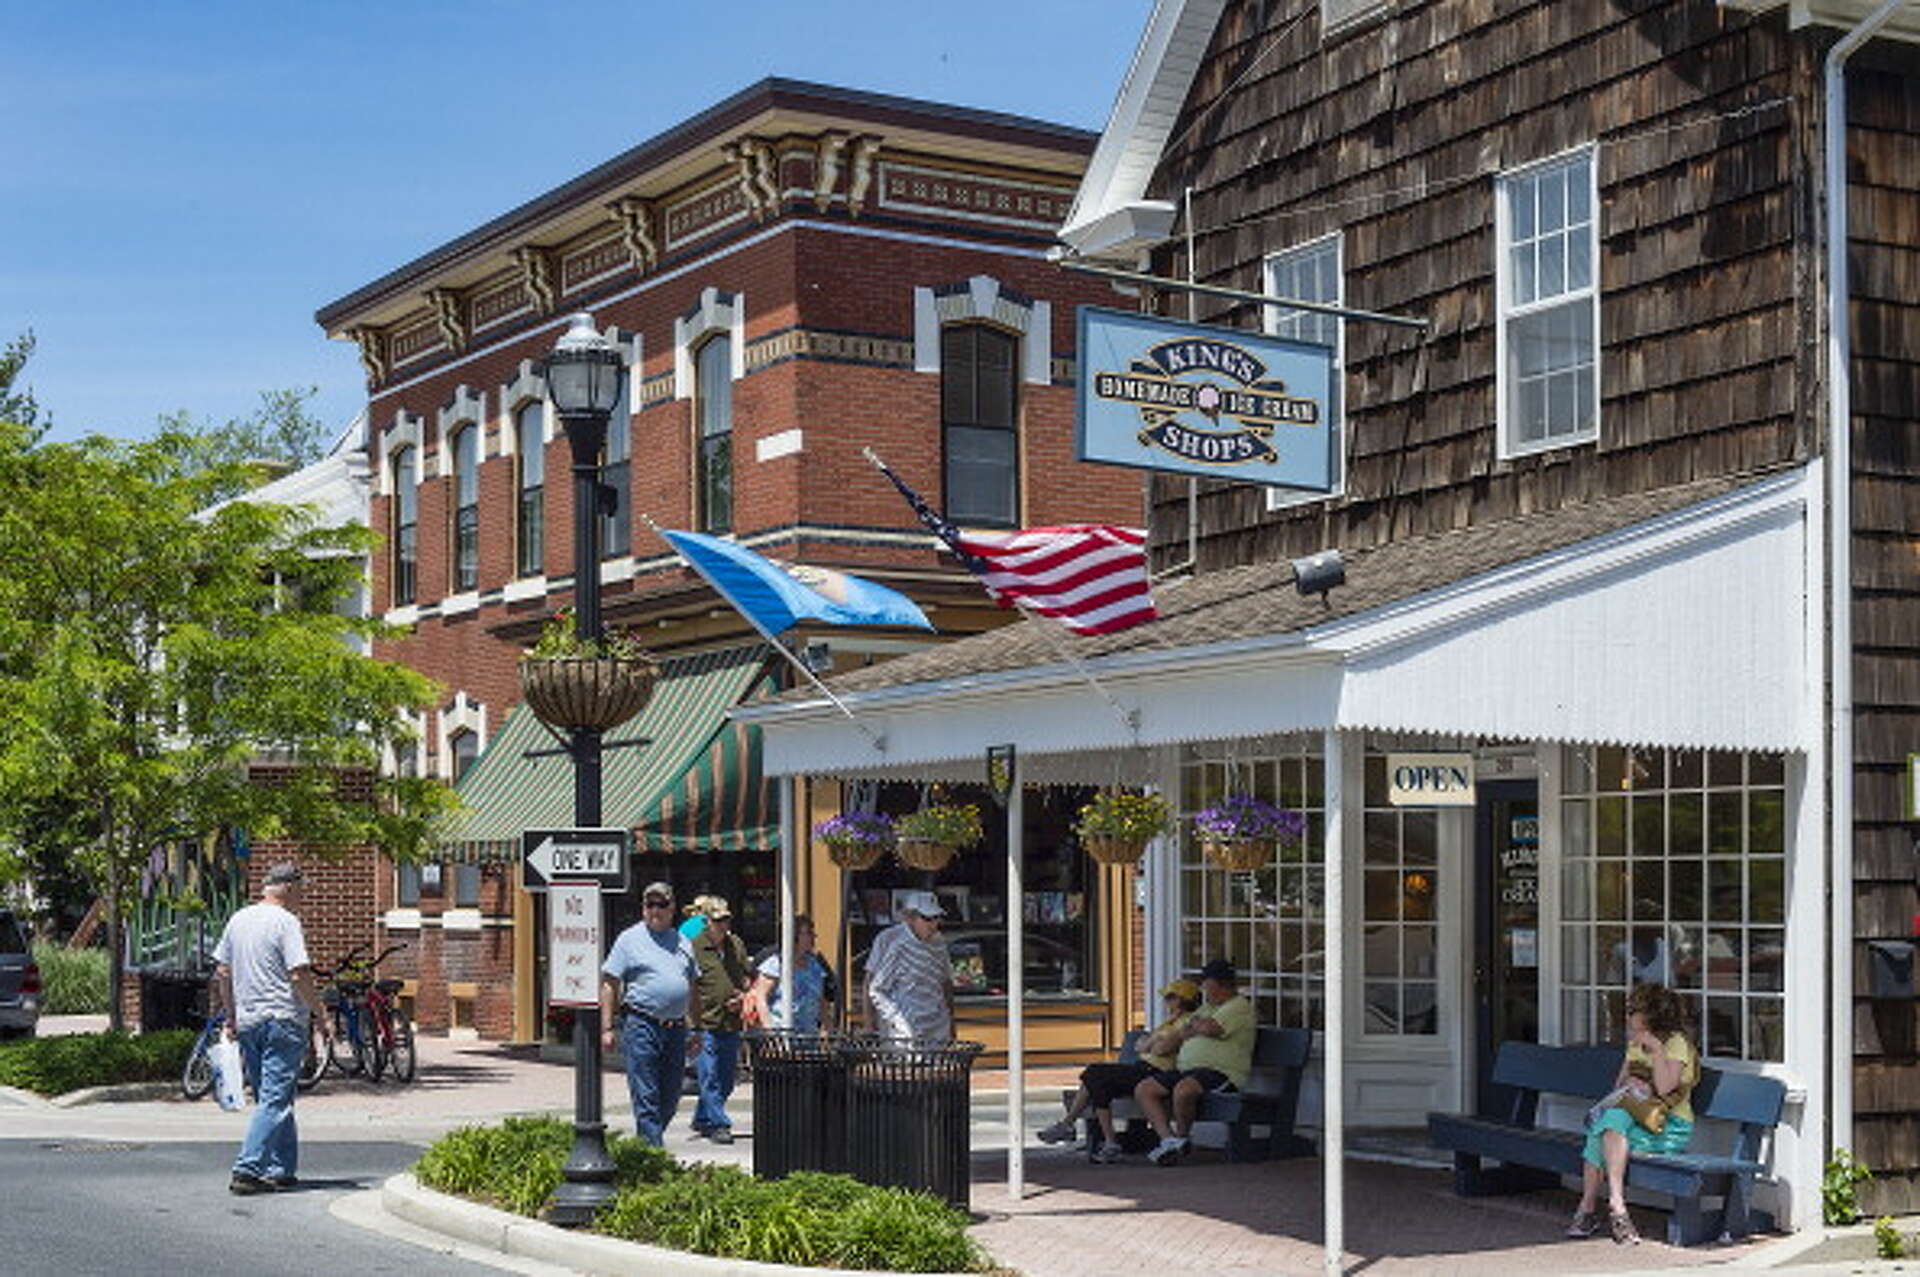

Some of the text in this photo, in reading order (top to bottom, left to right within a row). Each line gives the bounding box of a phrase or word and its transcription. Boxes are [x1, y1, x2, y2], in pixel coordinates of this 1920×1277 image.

[1100, 376, 1314, 422] HOMEMADE ICE CREAM
[1162, 425, 1254, 461] SHOPS
[1394, 765, 1469, 793] OPEN
[552, 848, 615, 871] ONE WAY
